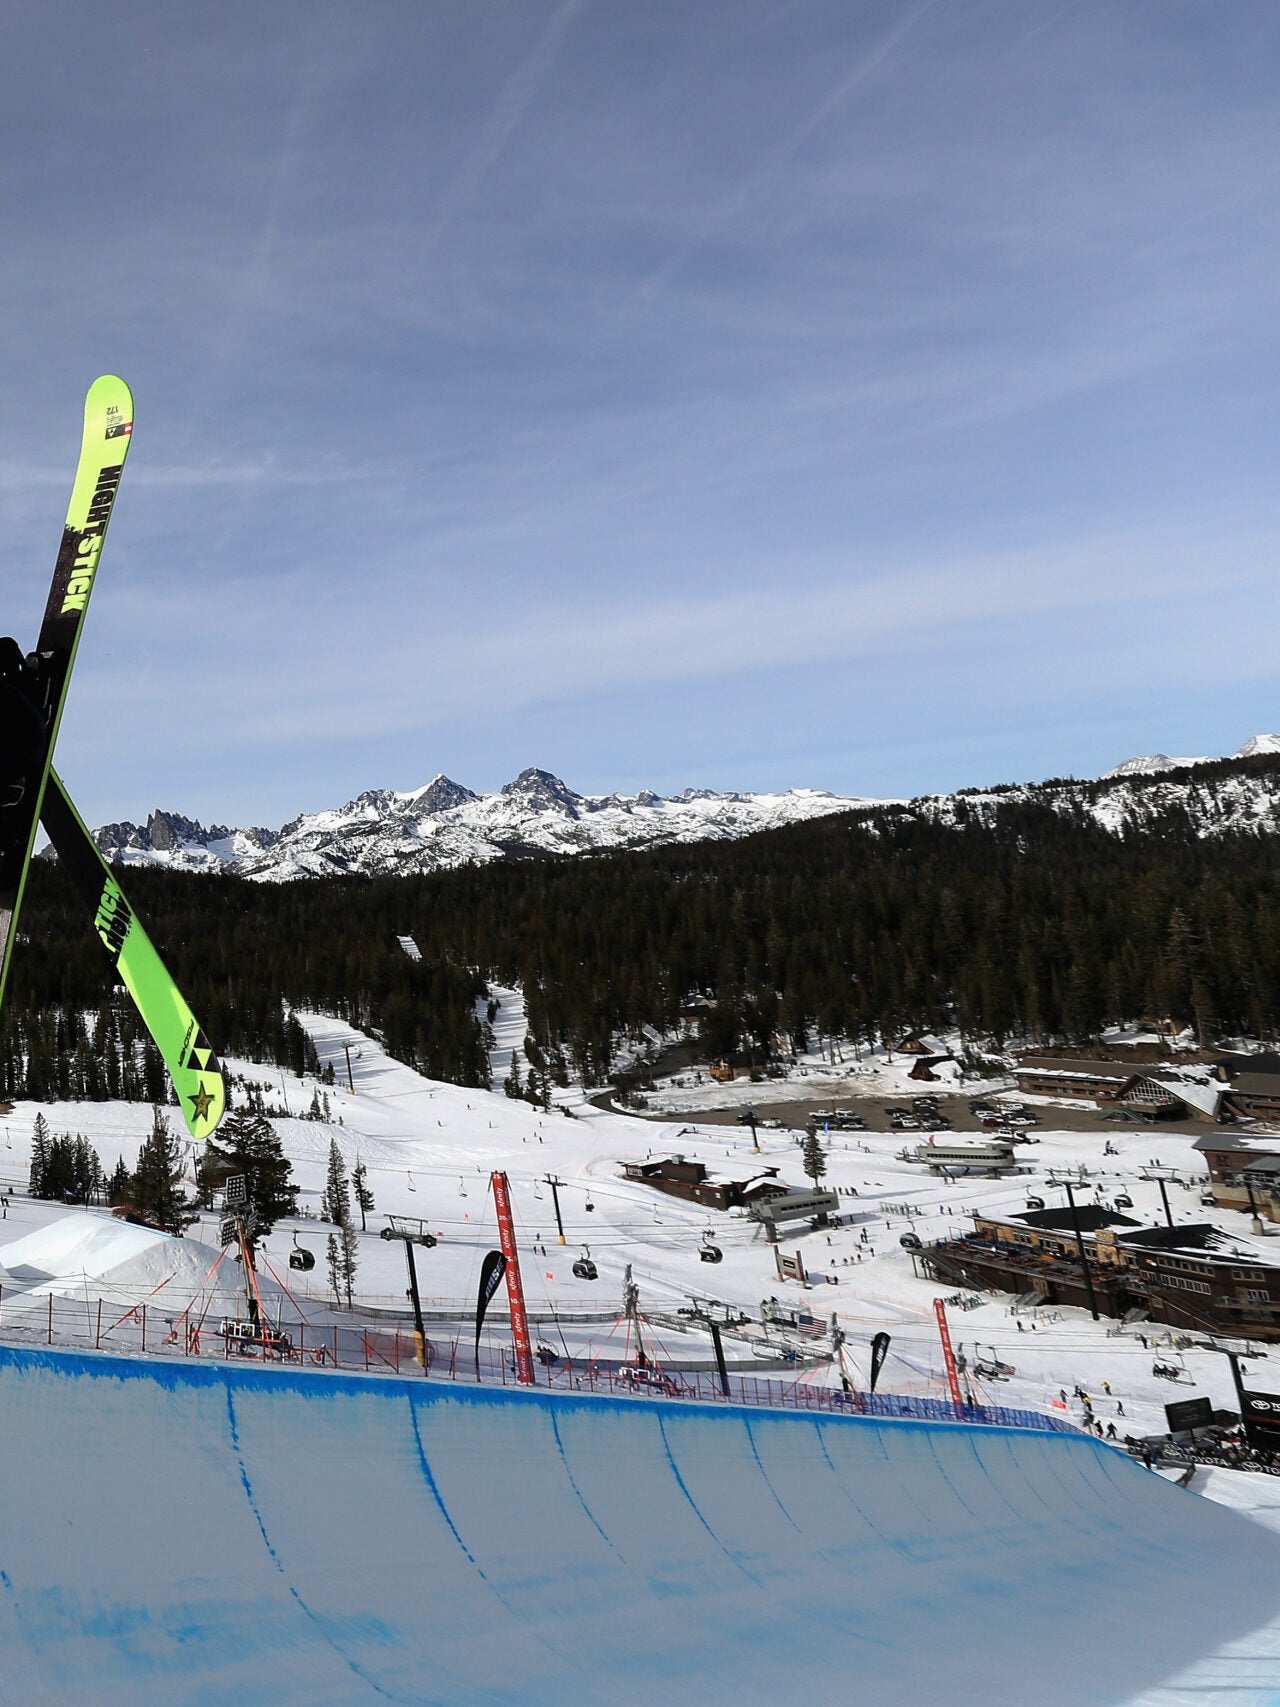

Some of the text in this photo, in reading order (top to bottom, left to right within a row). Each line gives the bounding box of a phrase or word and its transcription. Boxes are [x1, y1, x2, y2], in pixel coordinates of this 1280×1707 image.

[106, 405, 119, 415] 172
[178, 1019, 195, 1068] FISCHER
[496, 1187, 505, 1207] xfinity
[503, 1229, 511, 1249] xfinity
[509, 1270, 517, 1290] xfinity
[514, 1312, 522, 1333] xfinity
[1183, 1454, 1230, 1467] TOYOTA
